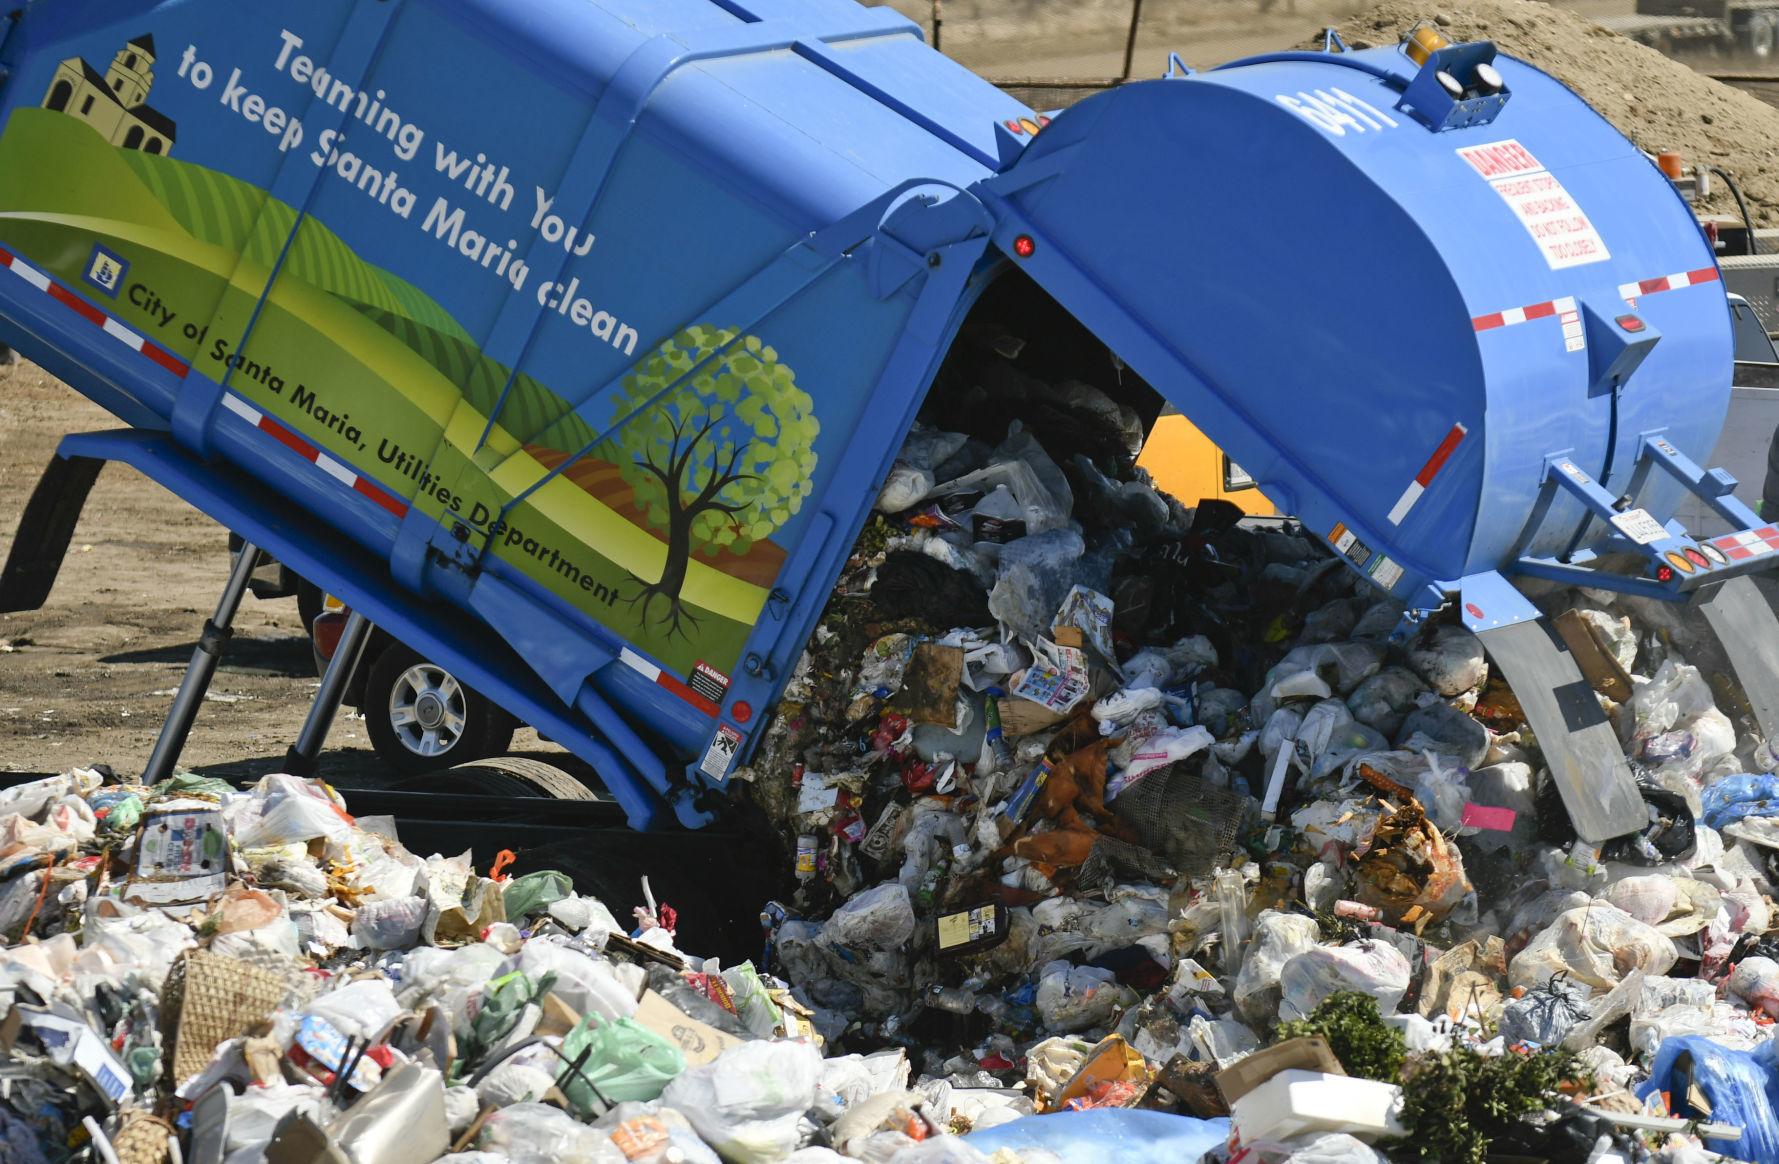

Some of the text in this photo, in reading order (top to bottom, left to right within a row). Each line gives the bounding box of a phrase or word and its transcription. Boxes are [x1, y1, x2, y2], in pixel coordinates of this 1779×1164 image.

[177, 44, 638, 356] to keep Santa Maria clean
[274, 28, 595, 256] Teaming with You
[1462, 143, 1539, 176] DANGER
[128, 283, 177, 328] City
[210, 338, 288, 394] Santa
[288, 384, 367, 452] Maria,
[377, 438, 463, 512] Utilities
[468, 502, 619, 608] Department
[704, 666, 729, 686] DANGER
